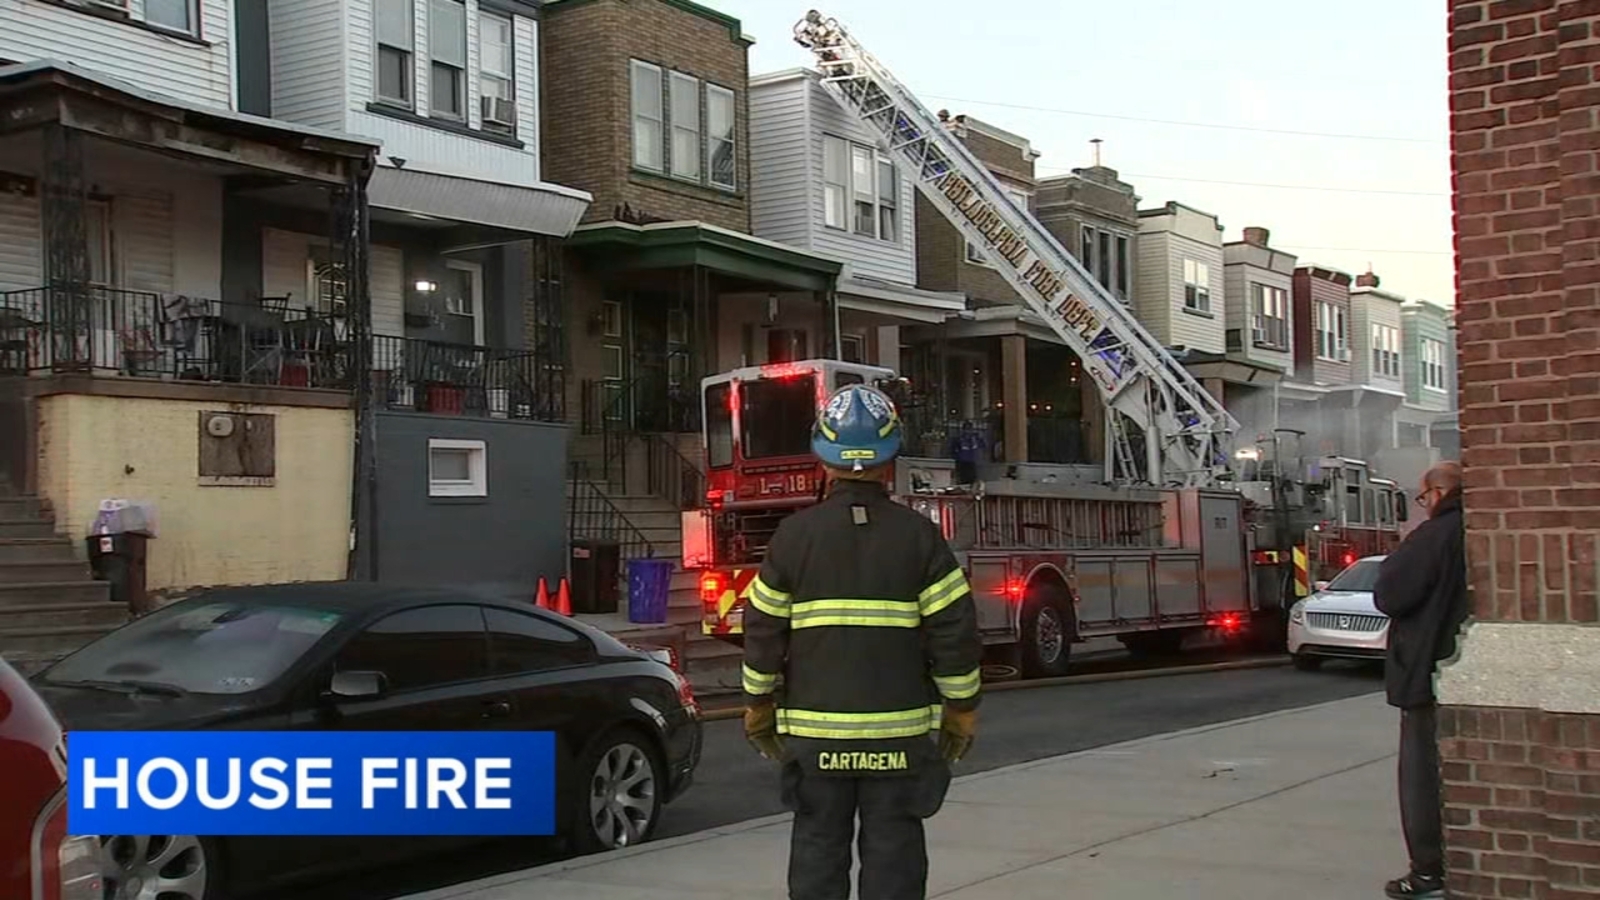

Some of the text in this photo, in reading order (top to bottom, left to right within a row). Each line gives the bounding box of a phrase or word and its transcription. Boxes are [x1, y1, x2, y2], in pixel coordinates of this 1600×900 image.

[938, 171, 1028, 269] PHILADELPHIA
[1023, 259, 1066, 302] FIRE
[818, 752, 907, 771] CARTAGENA
